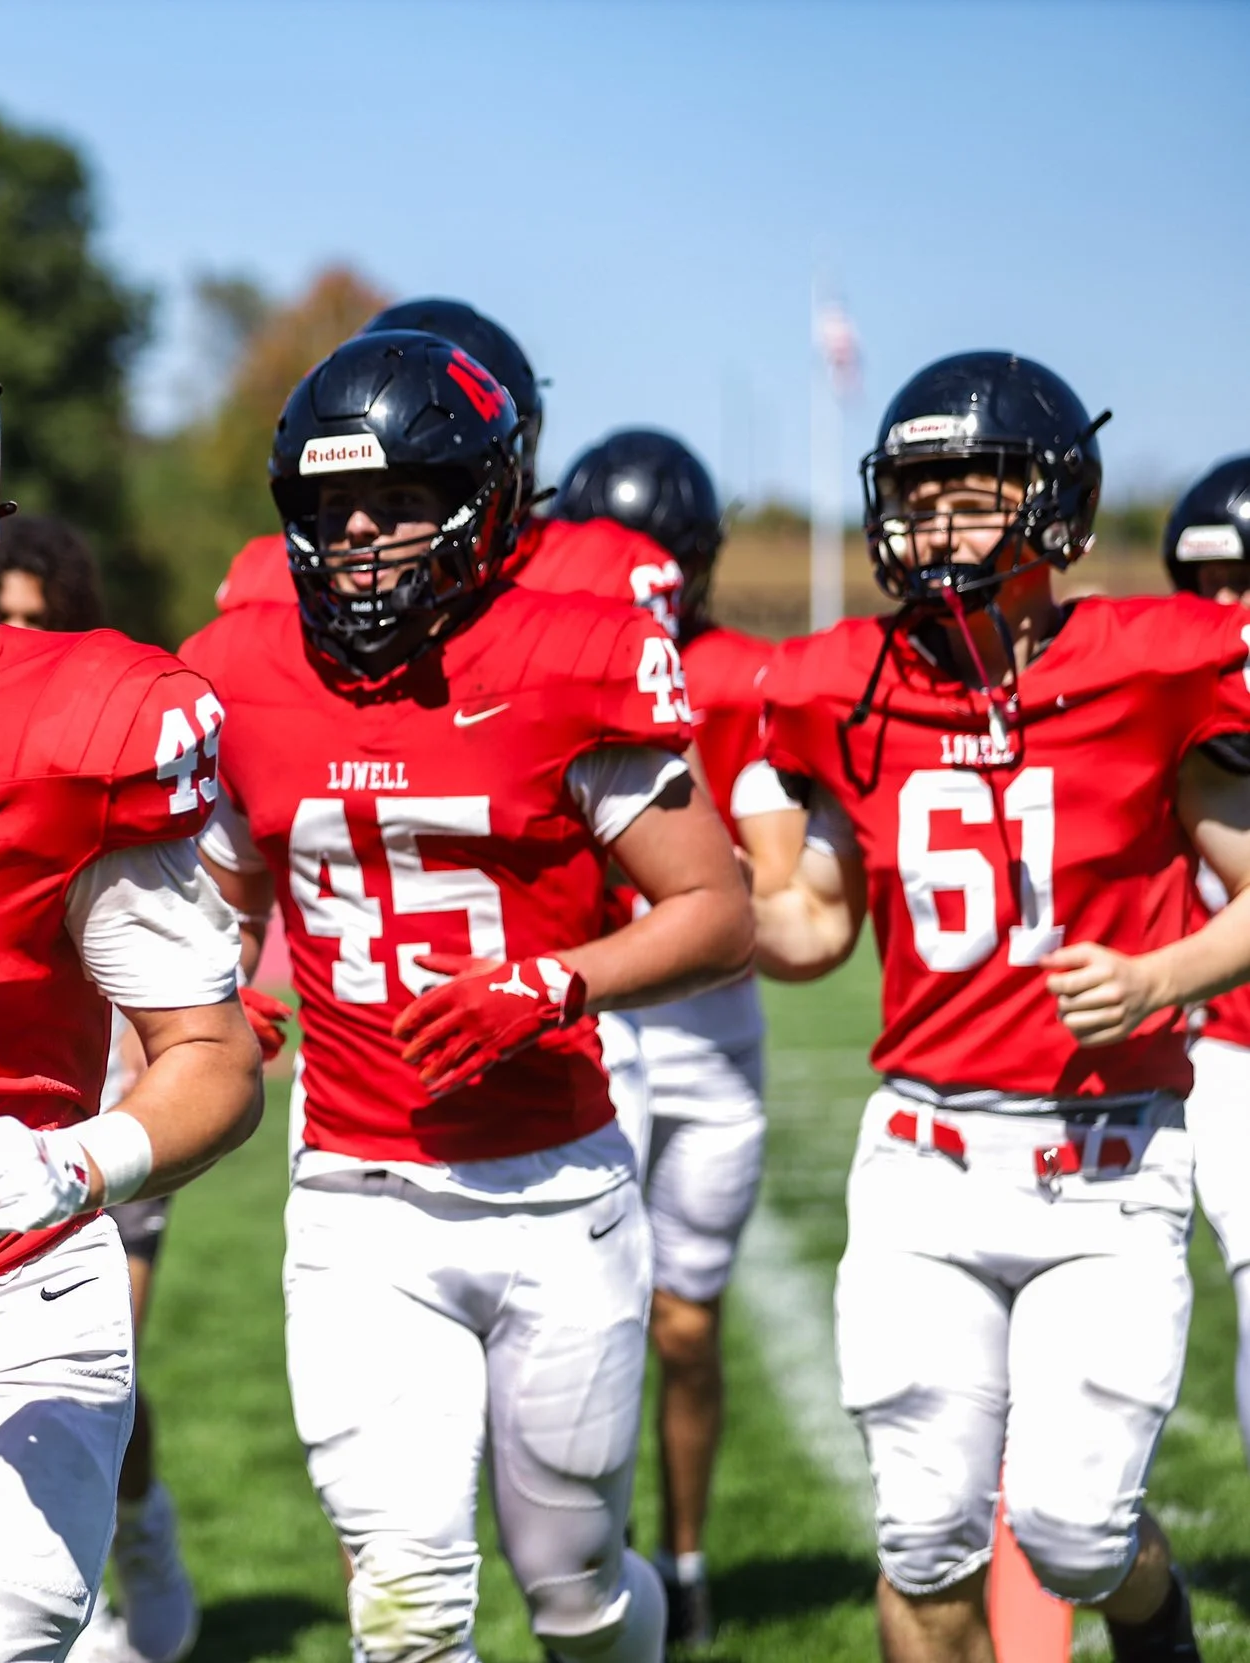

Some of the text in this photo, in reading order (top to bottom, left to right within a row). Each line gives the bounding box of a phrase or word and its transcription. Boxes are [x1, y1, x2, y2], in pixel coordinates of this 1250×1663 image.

[307, 445, 372, 463] Riddell
[154, 692, 225, 815] 49
[326, 761, 409, 791] LOWELL
[289, 796, 507, 1003] 45
[897, 767, 1066, 972] 61
